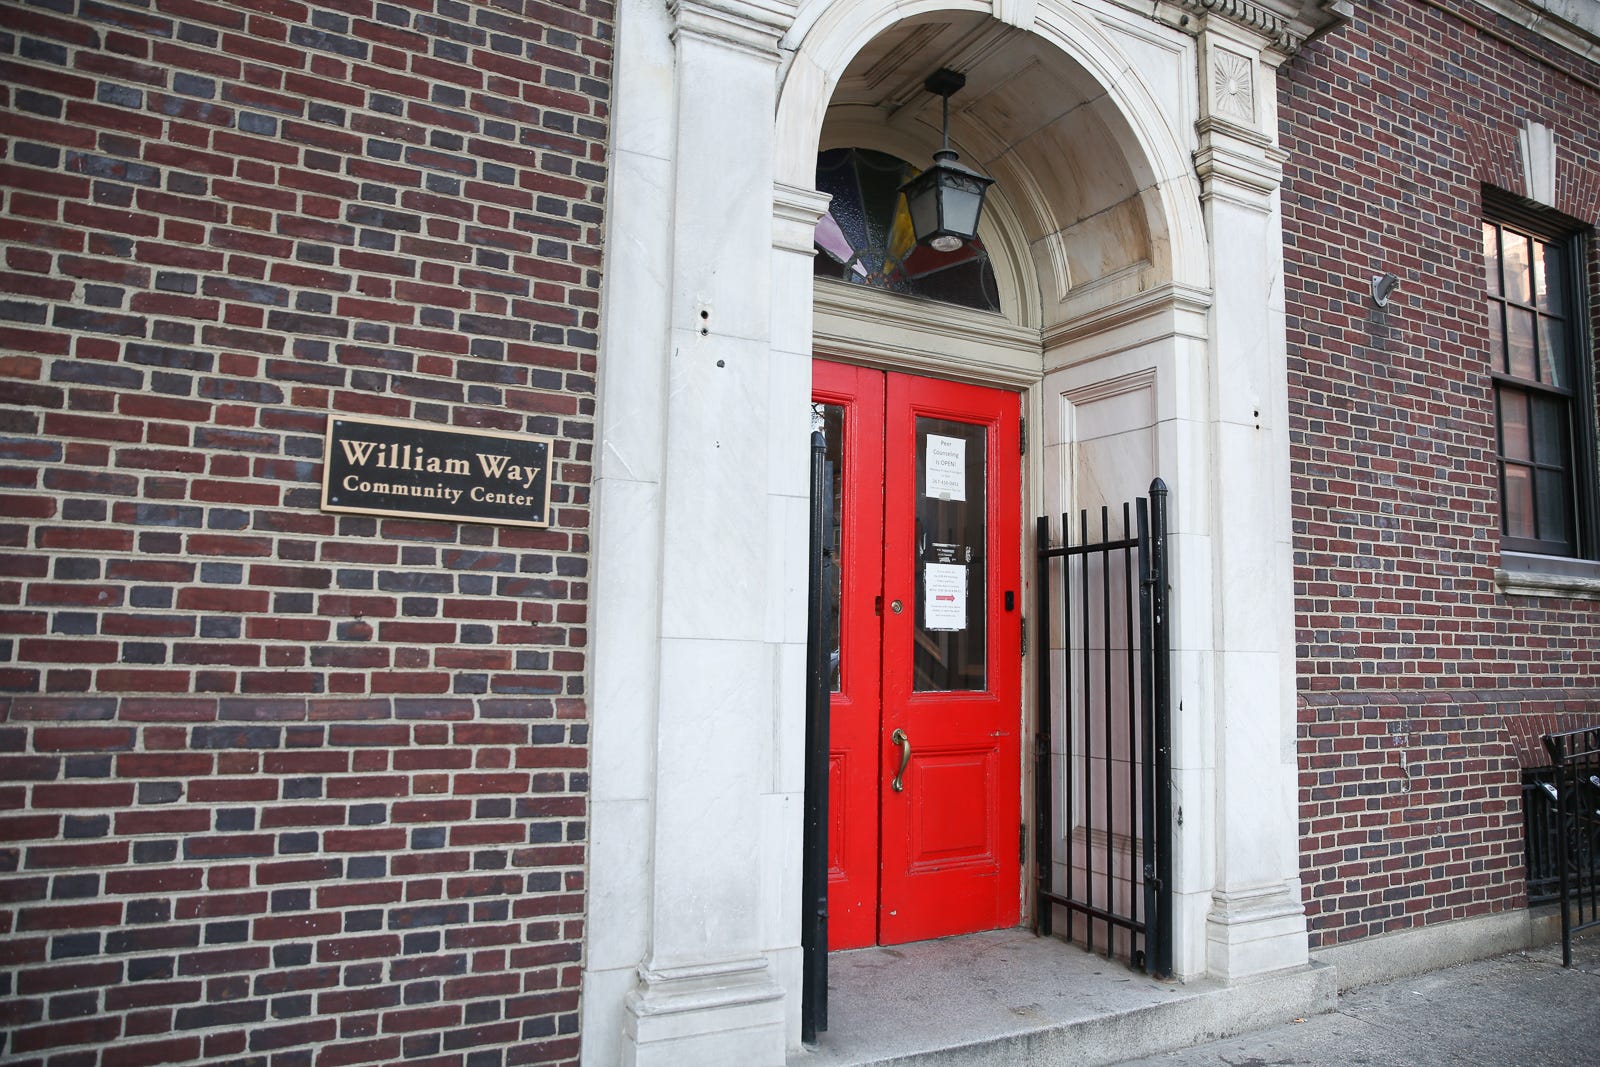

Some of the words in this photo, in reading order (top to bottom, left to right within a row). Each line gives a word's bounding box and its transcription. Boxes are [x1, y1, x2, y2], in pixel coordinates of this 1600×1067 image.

[338, 439, 471, 476] William
[476, 453, 541, 489] Way
[933, 449, 960, 459] Counseling
[343, 475, 463, 504] Community
[470, 486, 534, 506] Center
